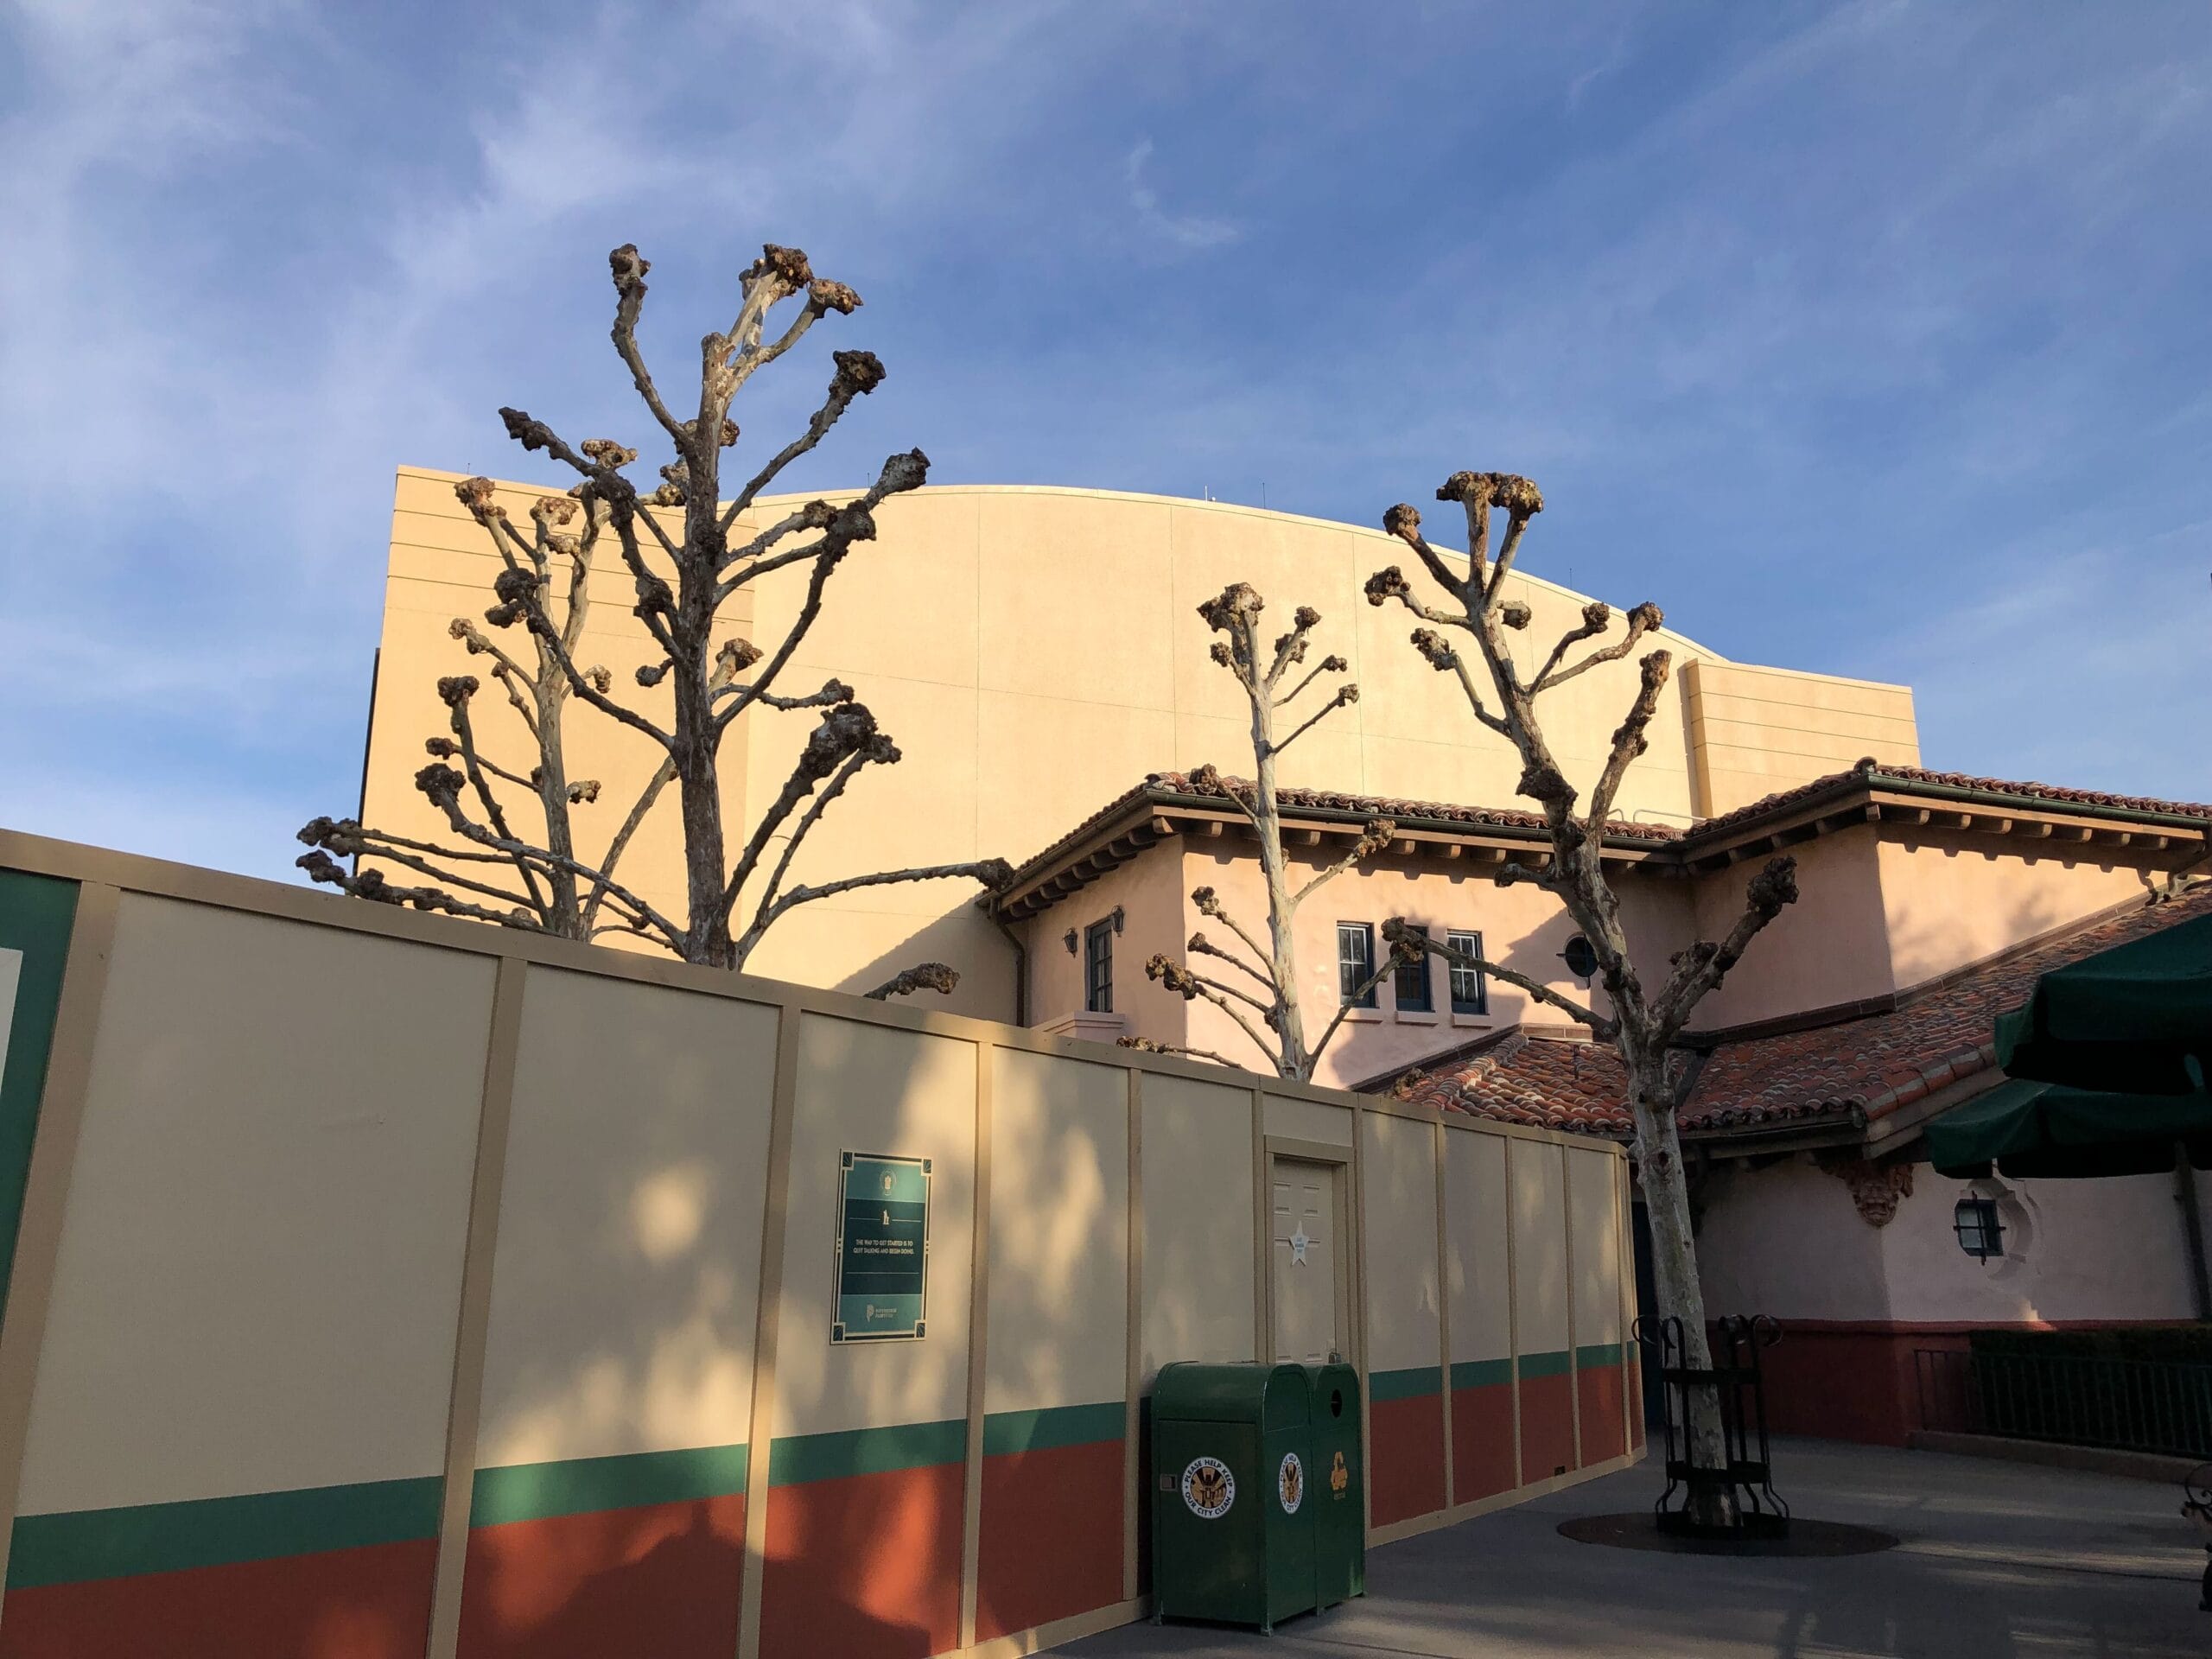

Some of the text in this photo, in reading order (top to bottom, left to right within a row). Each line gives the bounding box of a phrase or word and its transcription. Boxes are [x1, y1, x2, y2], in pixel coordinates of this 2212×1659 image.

[1184, 1459, 1233, 1487] PLEASE HELP KEEP
[1185, 1491, 1232, 1516] OUR CITY CLEAN
